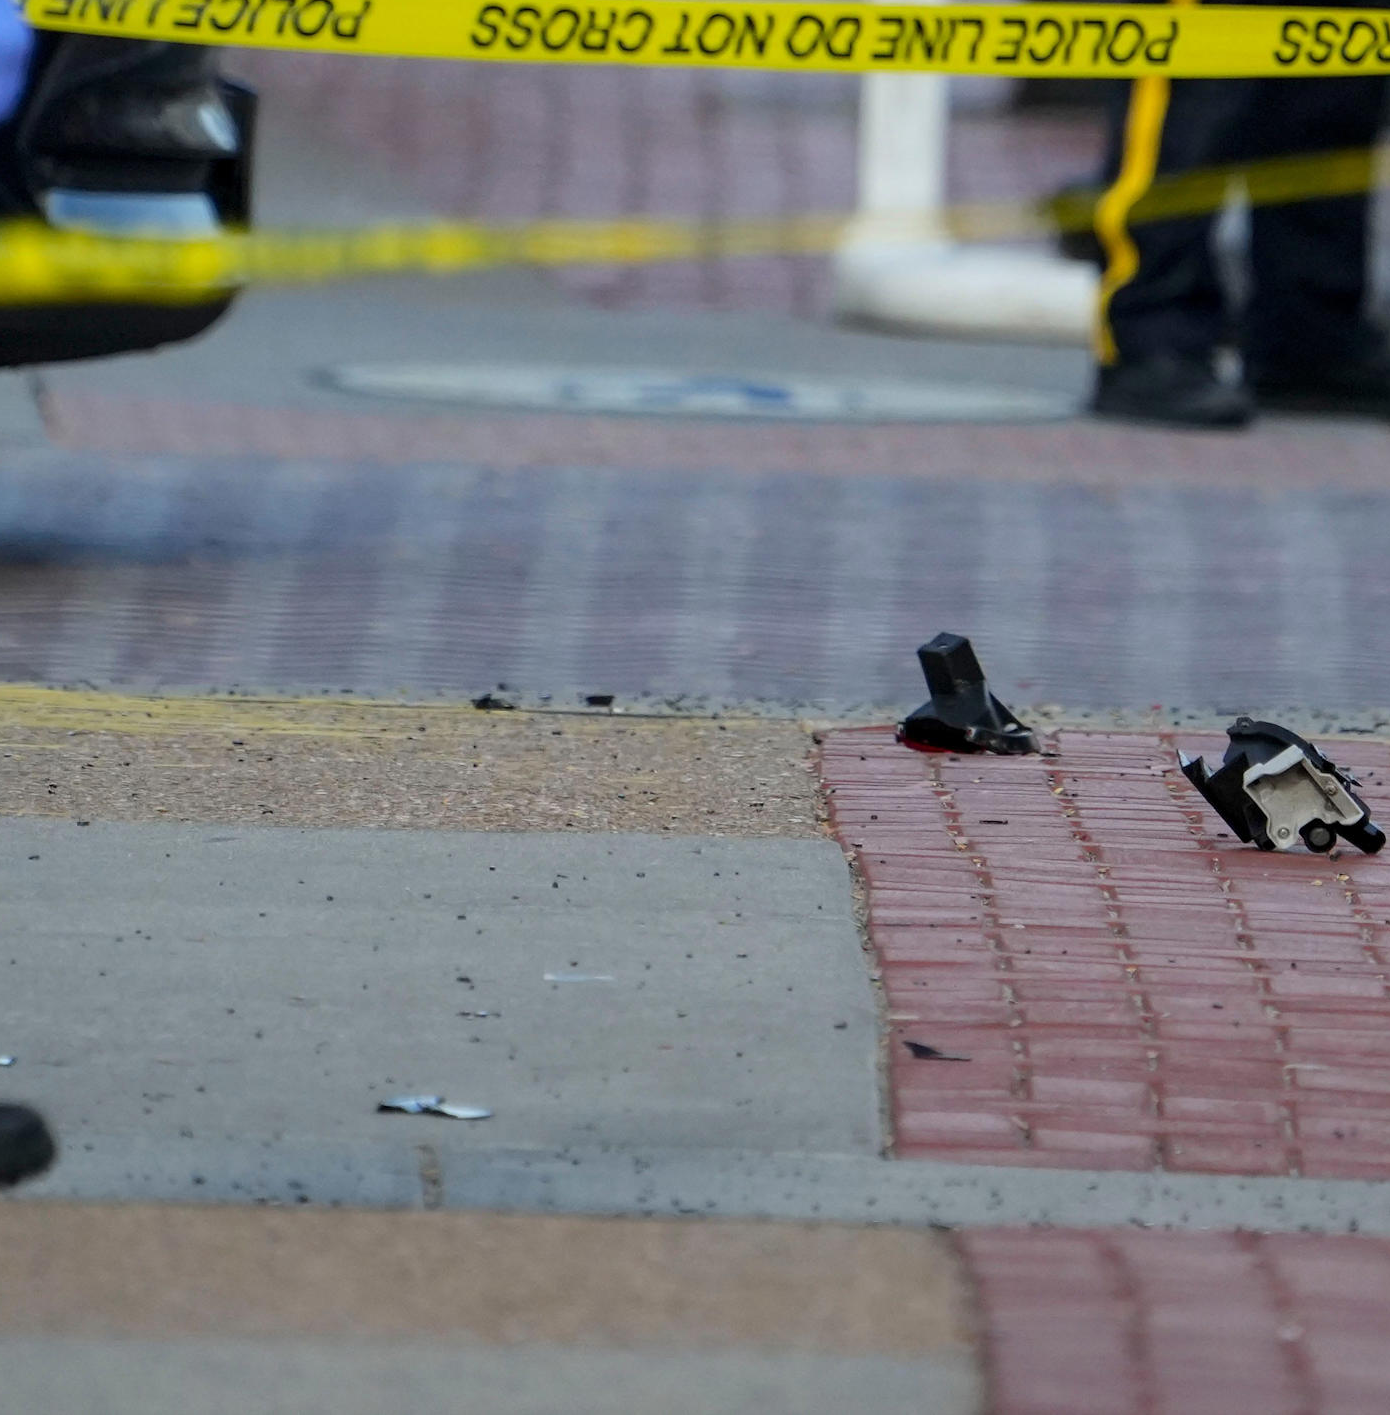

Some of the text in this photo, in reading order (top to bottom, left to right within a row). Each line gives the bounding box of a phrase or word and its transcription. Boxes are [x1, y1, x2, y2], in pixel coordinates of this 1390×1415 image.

[470, 4, 1179, 64] POLICE LINE DO NOT CROSS
